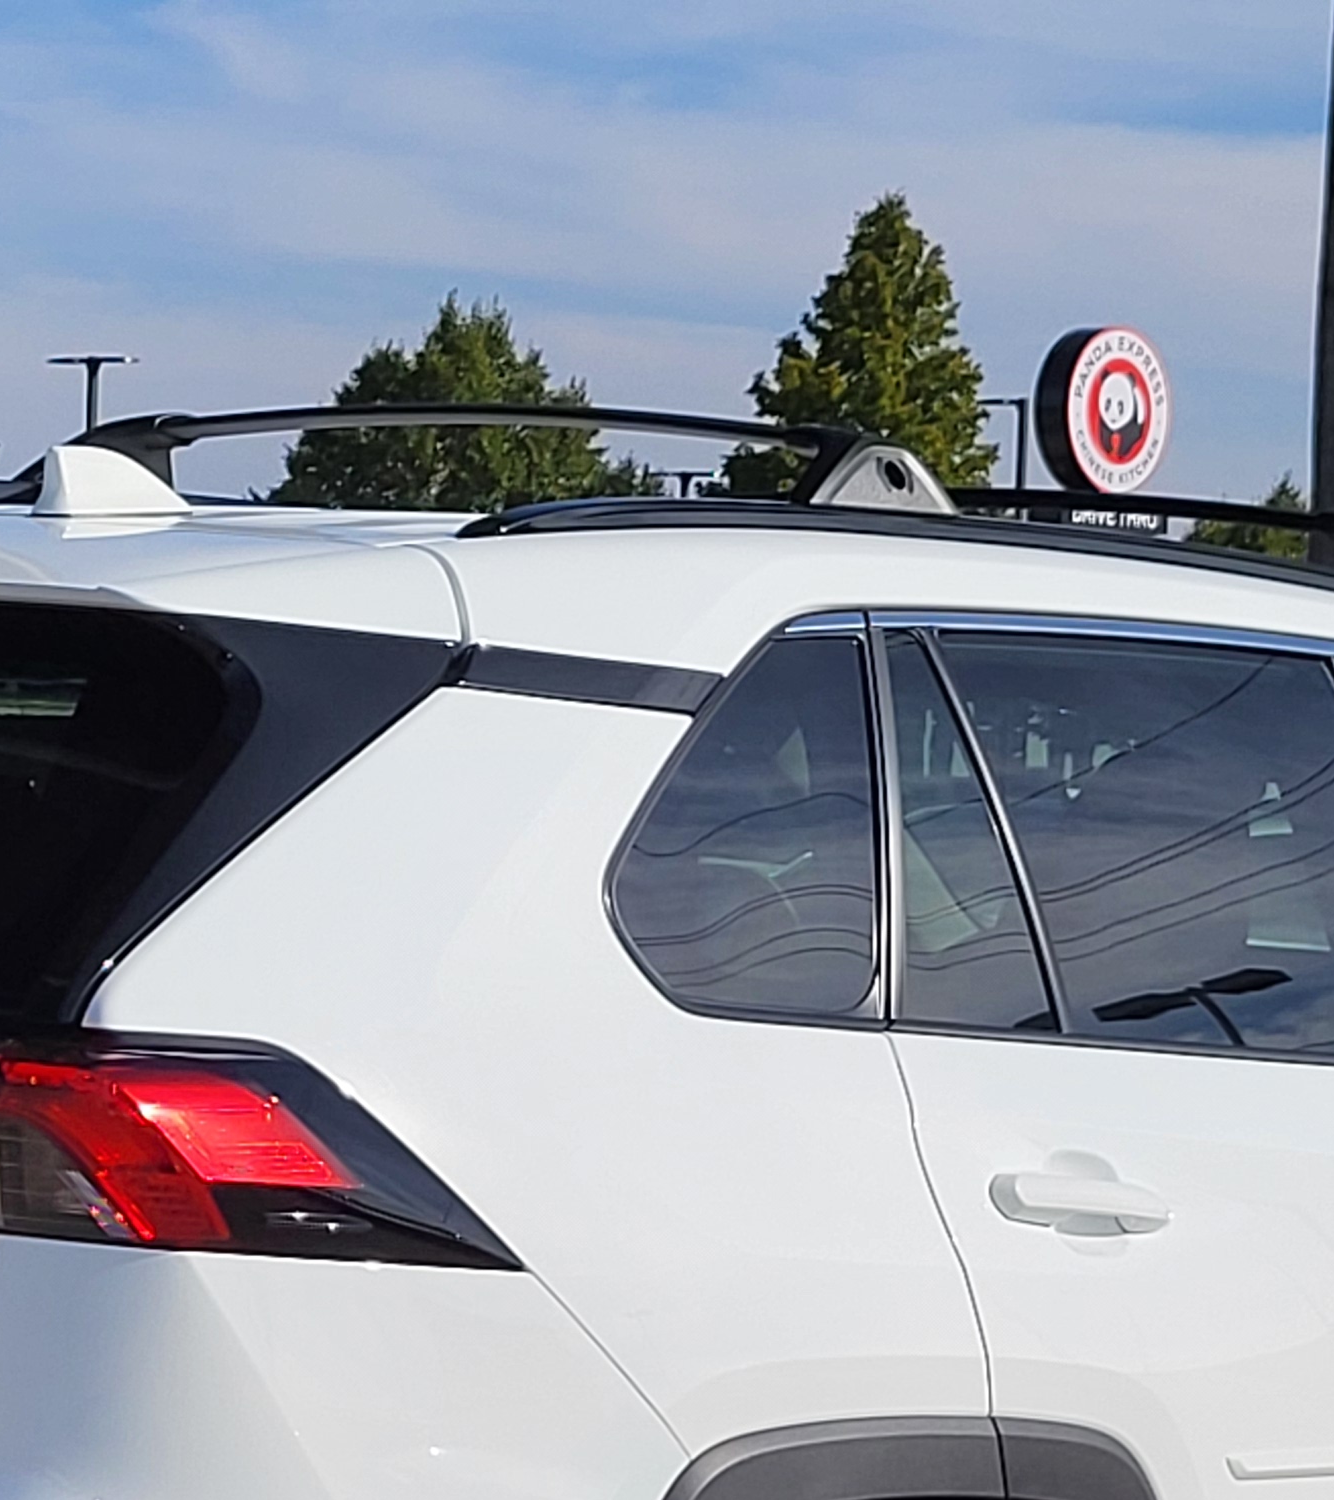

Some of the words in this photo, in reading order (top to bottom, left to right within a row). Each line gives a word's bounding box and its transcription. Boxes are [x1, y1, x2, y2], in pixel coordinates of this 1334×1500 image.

[1075, 340, 1113, 399] PANDA
[1118, 336, 1165, 407] EXPRESS
[1077, 430, 1113, 484] CHINESE
